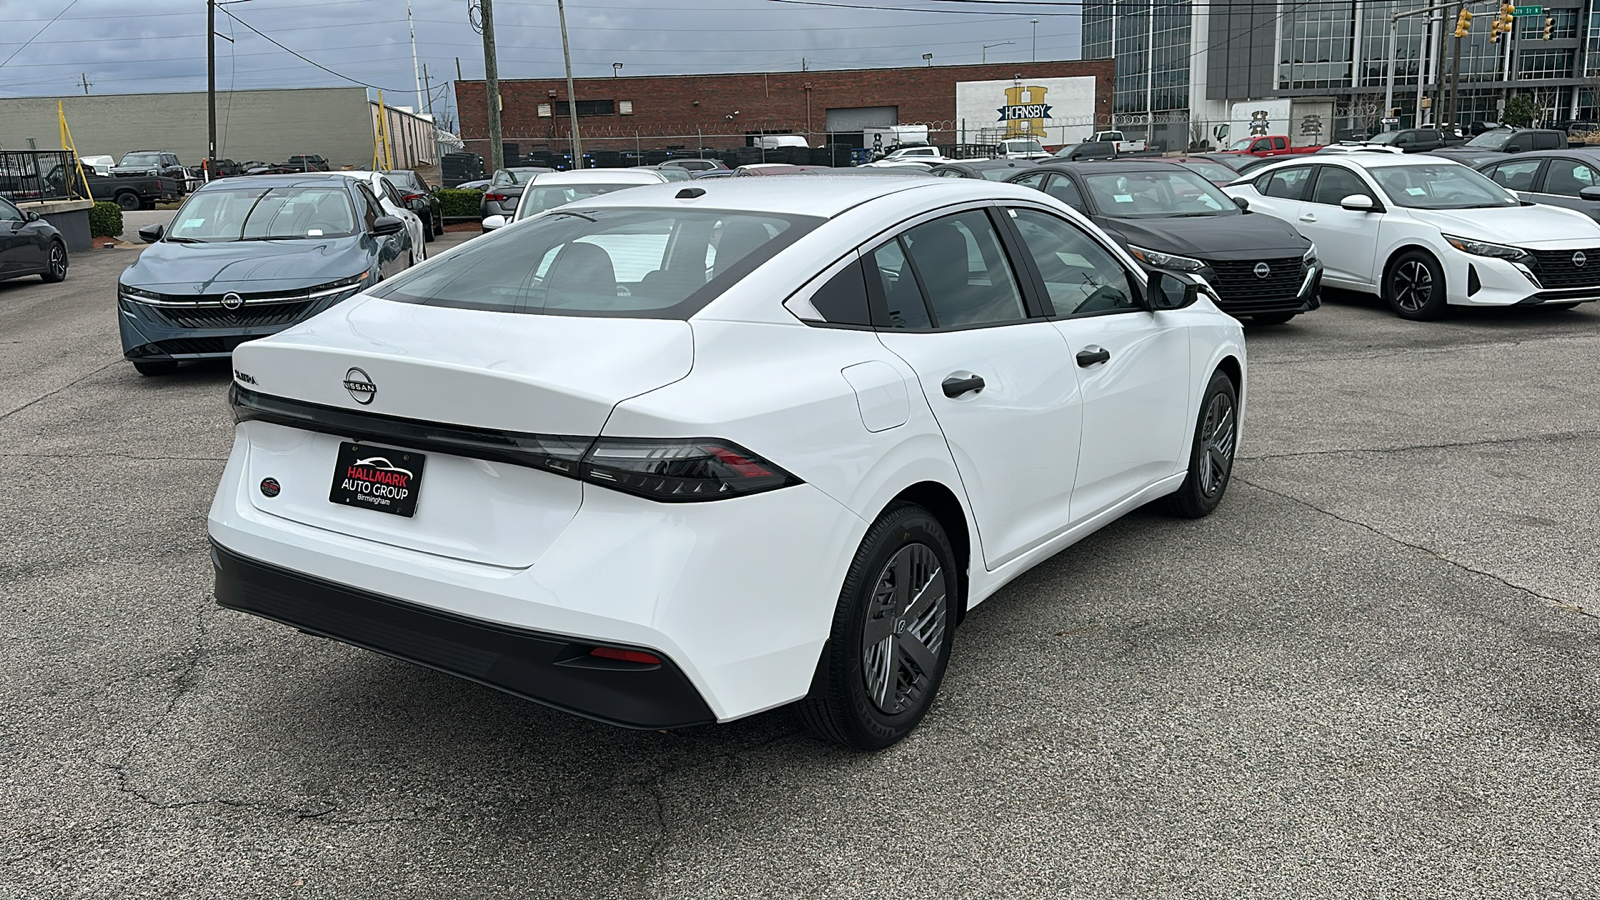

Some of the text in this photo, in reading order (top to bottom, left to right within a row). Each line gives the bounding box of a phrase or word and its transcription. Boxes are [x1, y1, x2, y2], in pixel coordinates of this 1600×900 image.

[1005, 105, 1046, 120] HORNSBY
[343, 382, 375, 392] NISSAN
[347, 466, 408, 488] HALLMARK
[341, 478, 408, 500] AUTO GROUP
[357, 493, 391, 506] Birmingham
